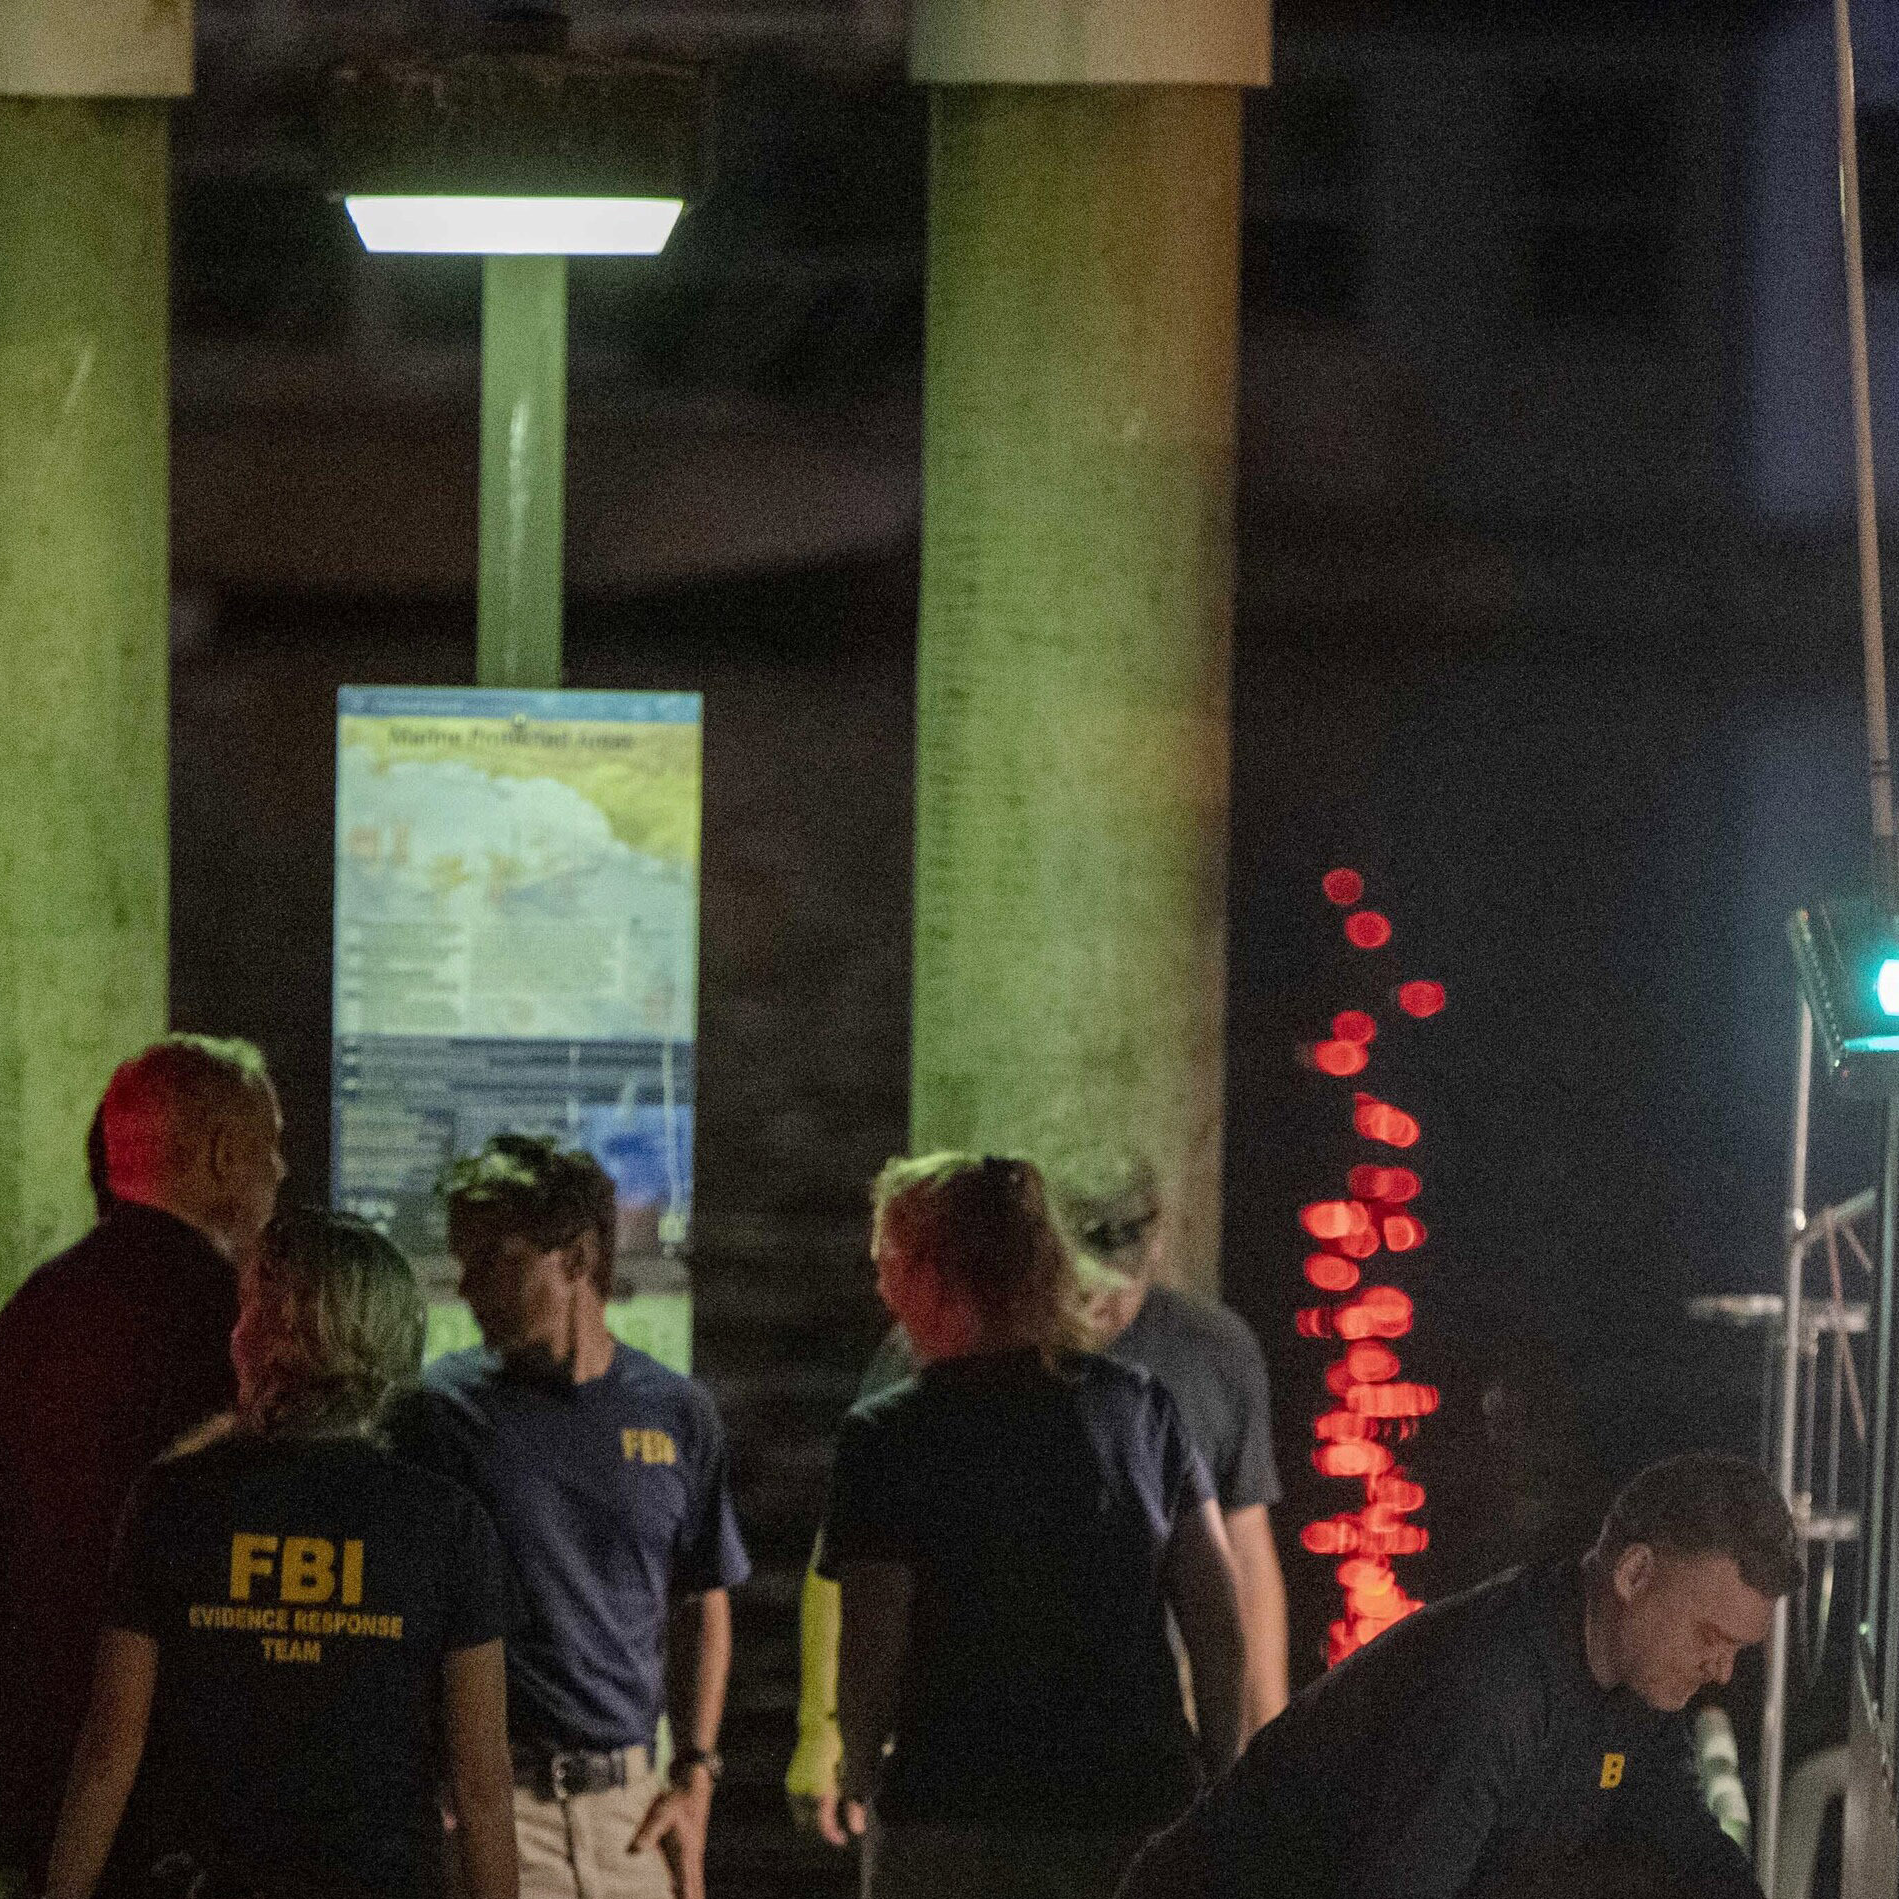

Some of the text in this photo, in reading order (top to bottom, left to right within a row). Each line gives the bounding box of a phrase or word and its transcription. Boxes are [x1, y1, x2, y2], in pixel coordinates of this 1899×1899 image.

[229, 1532, 365, 1606] FBI
[188, 1603, 404, 1640] EVIDENCE RESPONSE
[261, 1637, 322, 1664] TEAM
